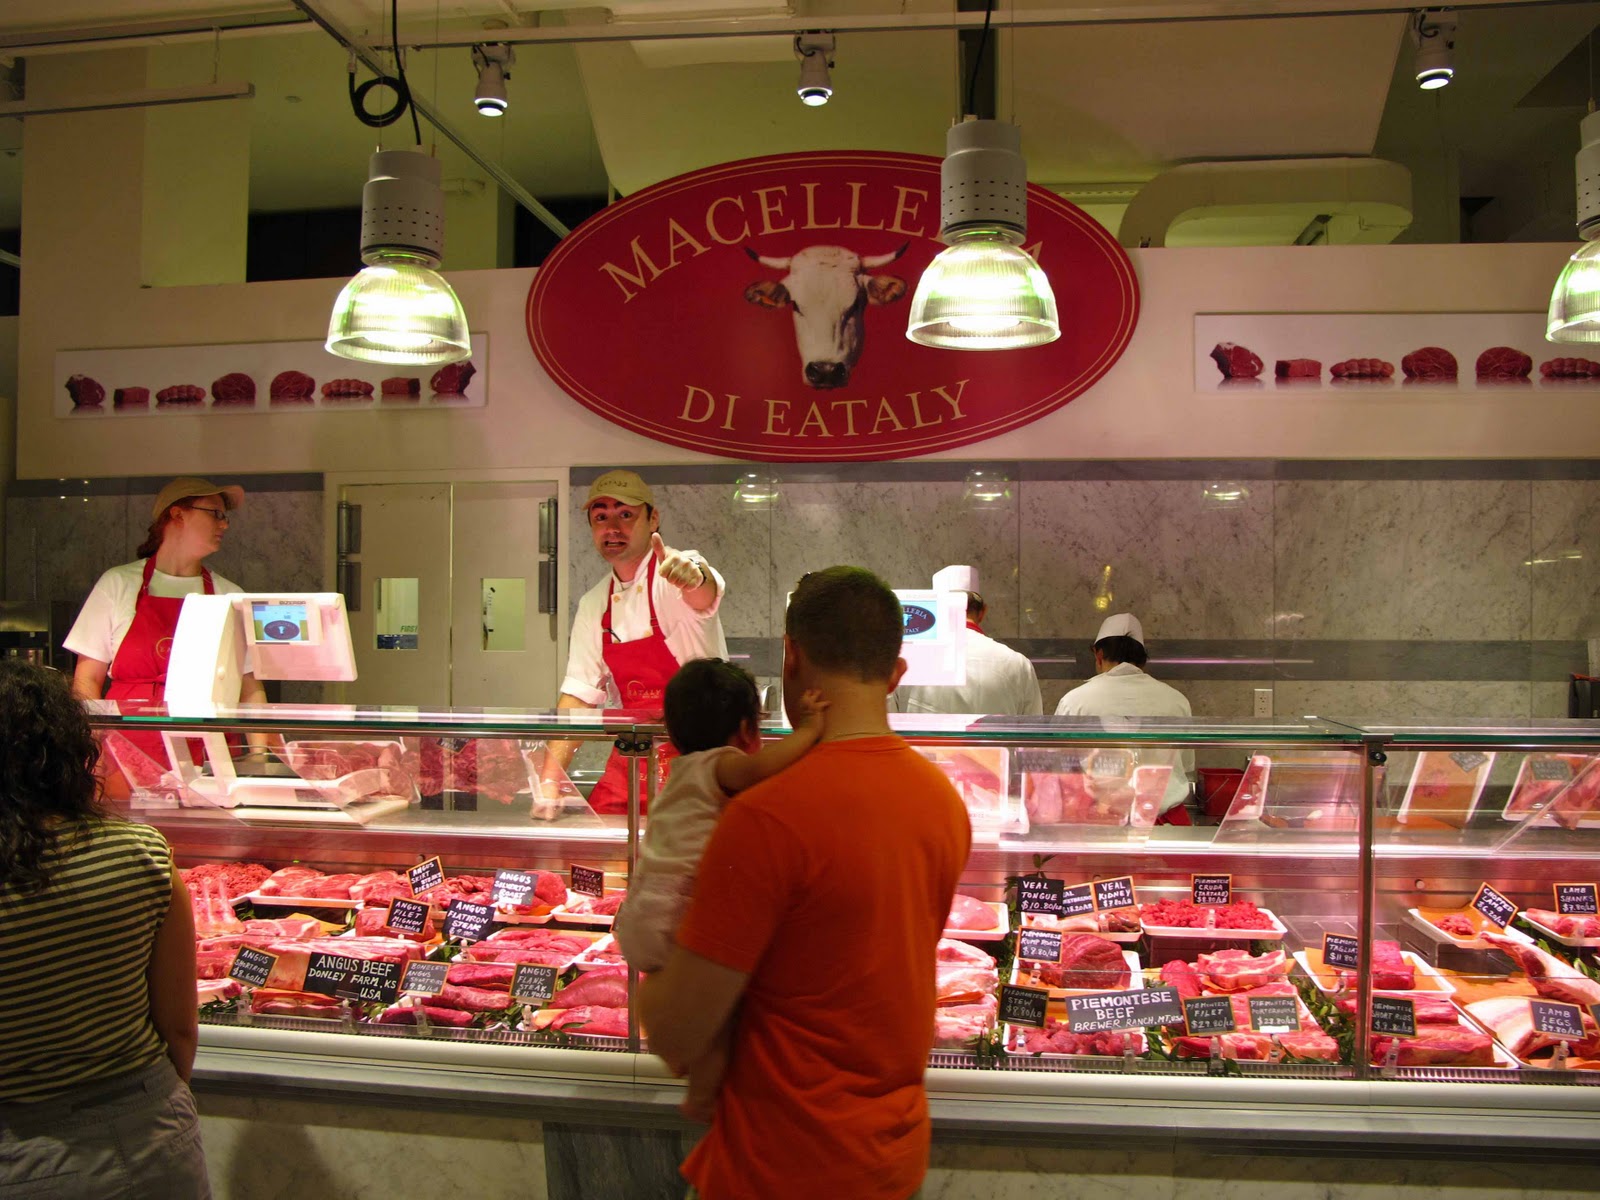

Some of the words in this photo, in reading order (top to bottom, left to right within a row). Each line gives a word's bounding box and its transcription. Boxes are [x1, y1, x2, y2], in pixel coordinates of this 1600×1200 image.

[599, 182, 1043, 304] MACELLE
[677, 385, 740, 430] DI
[761, 379, 970, 437] EATALY
[413, 862, 434, 876] ANGUS
[499, 872, 531, 884] ANGUS
[1023, 881, 1048, 889] VEAL
[1101, 882, 1126, 891] VEAL
[1021, 892, 1057, 900] TONGUE
[1098, 889, 1131, 900] KIDNEY
[1483, 888, 1513, 912] CHOPPED
[395, 901, 422, 912] ANGUS
[456, 901, 487, 914] ANGUS
[1481, 896, 1503, 912] LAMB
[393, 909, 422, 918] FILET
[447, 910, 489, 924] FLATIRON
[392, 916, 423, 926] MIGNON
[452, 920, 481, 931] STEAK
[1041, 939, 1061, 947] ROAST
[242, 949, 270, 964] ANGUS
[316, 955, 359, 972] ANGUS
[362, 960, 394, 977] BEEF
[520, 967, 552, 977] ANGUS
[308, 968, 346, 981] DONLEY
[384, 979, 397, 989] KS
[517, 976, 545, 985] FLANK
[520, 984, 547, 992] STEAK
[1008, 997, 1033, 1006] STEW
[1071, 991, 1172, 1011] PIEMONTESE
[1095, 1007, 1135, 1020] BEEF
[1194, 1009, 1223, 1017] FILET
[1539, 1007, 1571, 1018] LAMB
[1074, 1019, 1121, 1031] BREWER
[1541, 1016, 1571, 1026] LEGS
